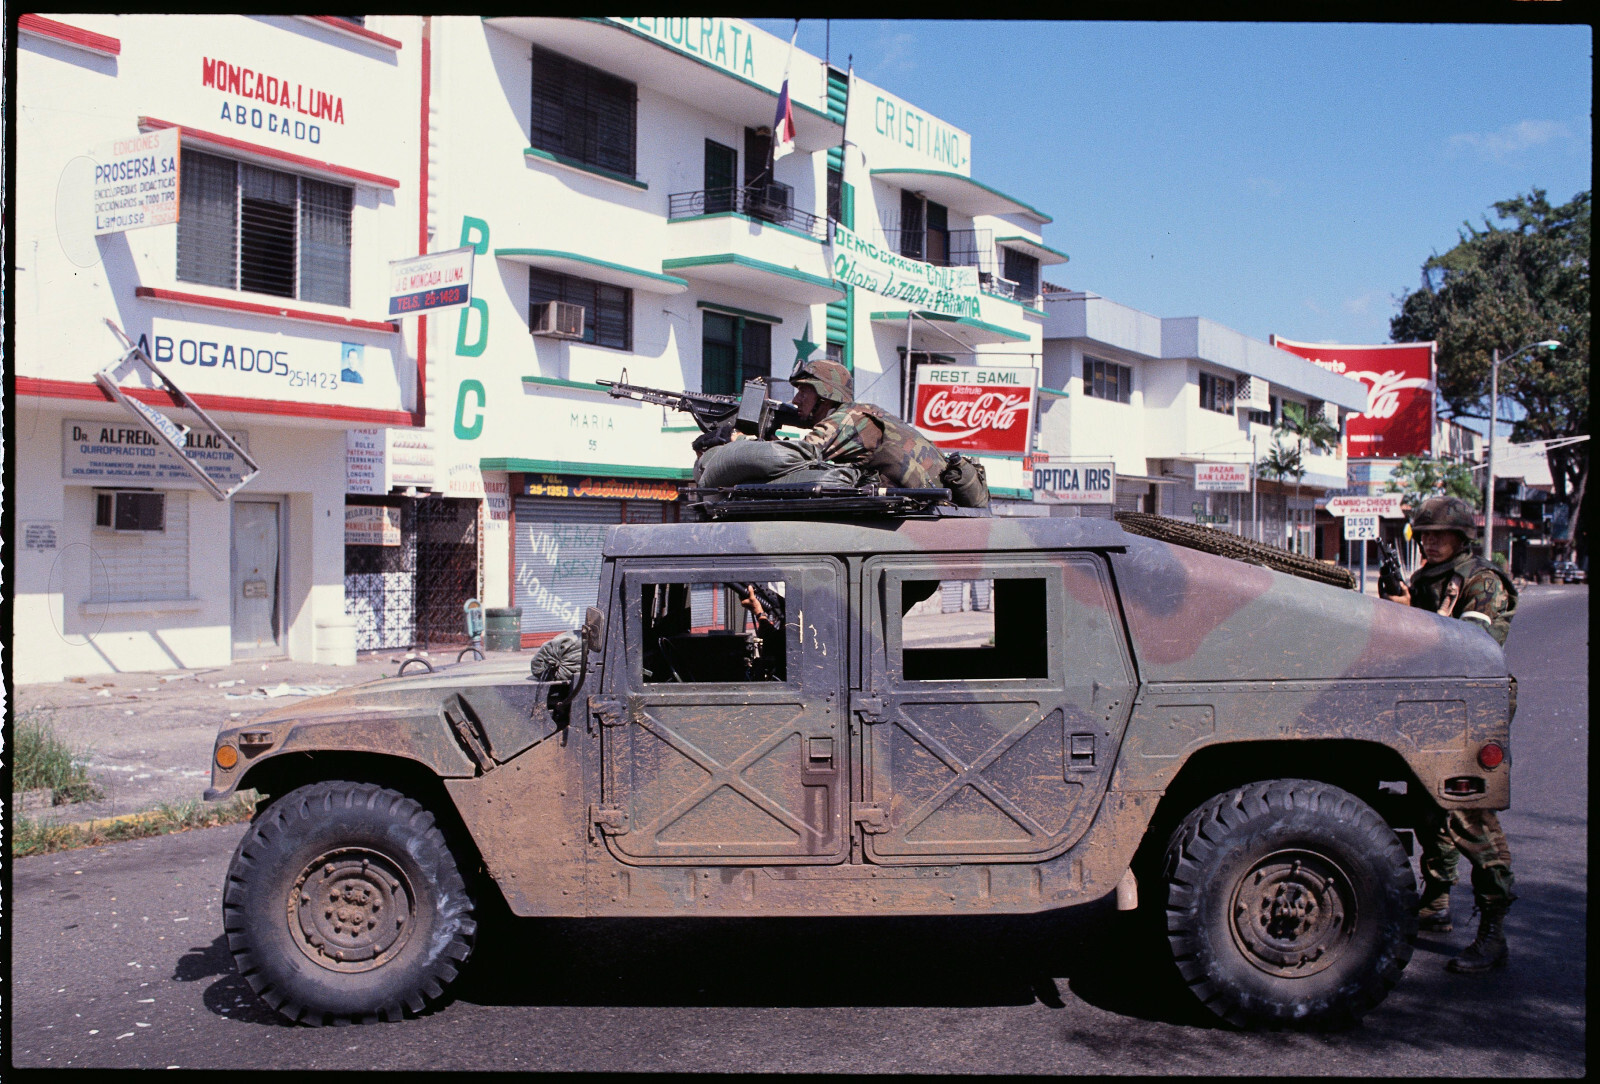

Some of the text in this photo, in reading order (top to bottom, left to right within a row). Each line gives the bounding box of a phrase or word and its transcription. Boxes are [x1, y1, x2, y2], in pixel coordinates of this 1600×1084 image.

[875, 96, 959, 168] CRISTIANO
[113, 134, 159, 156] EDICIONES
[96, 212, 145, 230] Larousse
[410, 270, 441, 289] MONCADA
[445, 266, 463, 283] LUNA
[397, 288, 460, 311] TELS. 25-1423
[930, 370, 1020, 385] REST. SAMIL
[951, 385, 983, 395] Disfrute
[923, 391, 1029, 430] Coca-Cola
[570, 412, 614, 431] MARIA
[80, 444, 156, 457] QUIROPRACTICO
[349, 485, 373, 493] INVICTA
[1034, 469, 1080, 490] OPTICA
[1085, 469, 1110, 490] IRIS
[1347, 518, 1374, 526] DESDE
[517, 562, 580, 631] NORIEGA
